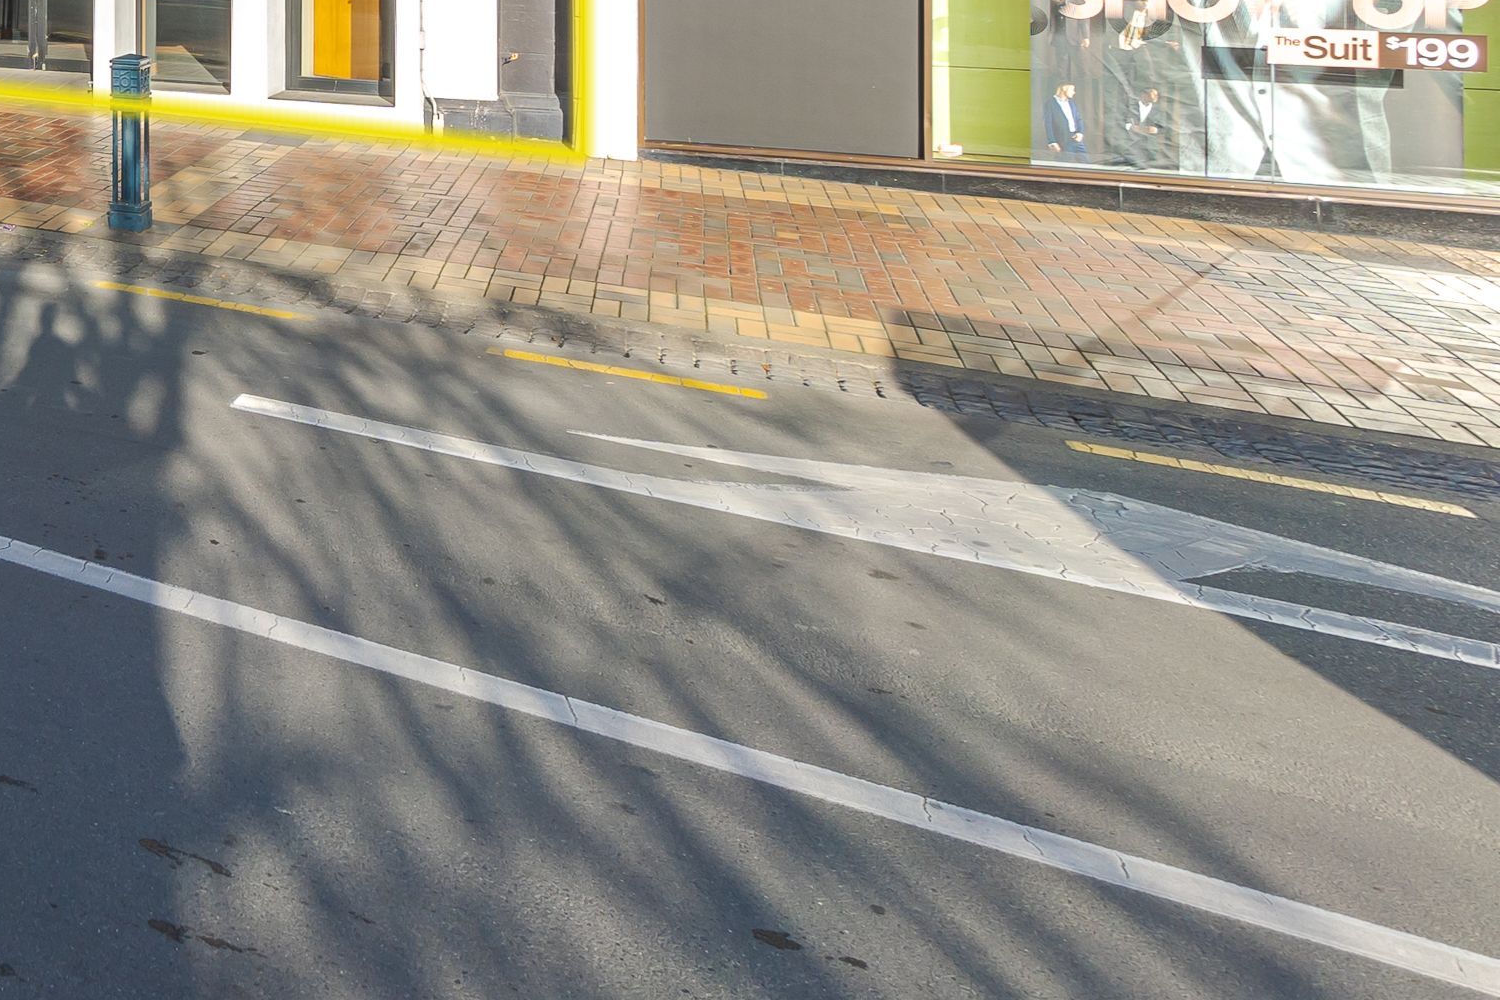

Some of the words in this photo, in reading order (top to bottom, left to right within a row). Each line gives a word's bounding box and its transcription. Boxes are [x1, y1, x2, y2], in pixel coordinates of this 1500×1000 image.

[1275, 36, 1301, 47] The
[1303, 36, 1373, 62] Suit
[1386, 37, 1480, 69] $199
